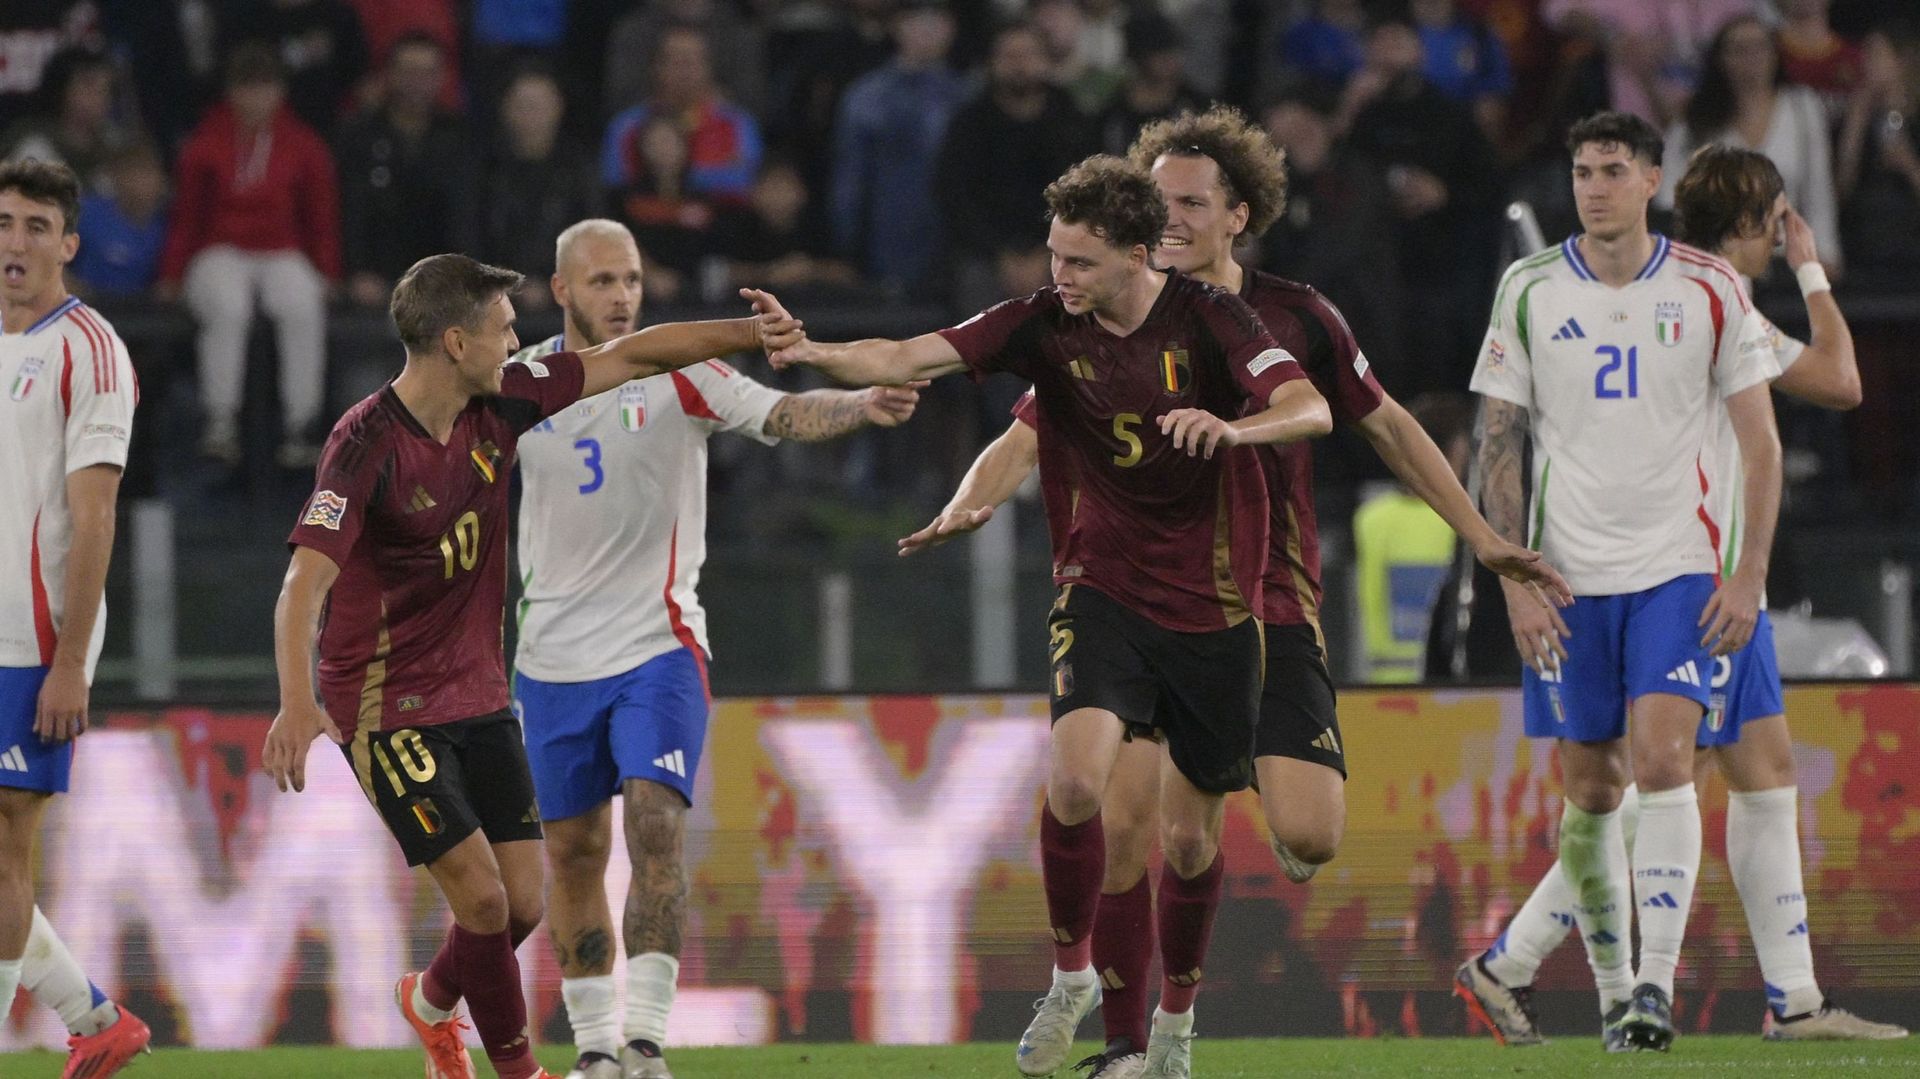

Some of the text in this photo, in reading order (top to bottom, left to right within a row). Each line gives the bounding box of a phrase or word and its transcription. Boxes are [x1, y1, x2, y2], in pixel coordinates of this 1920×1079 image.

[1595, 345, 1638, 398] 21
[574, 438, 604, 495] 3
[1113, 412, 1143, 468] 5
[439, 511, 480, 579] 10
[1049, 617, 1075, 664] 5
[373, 728, 437, 798] 10
